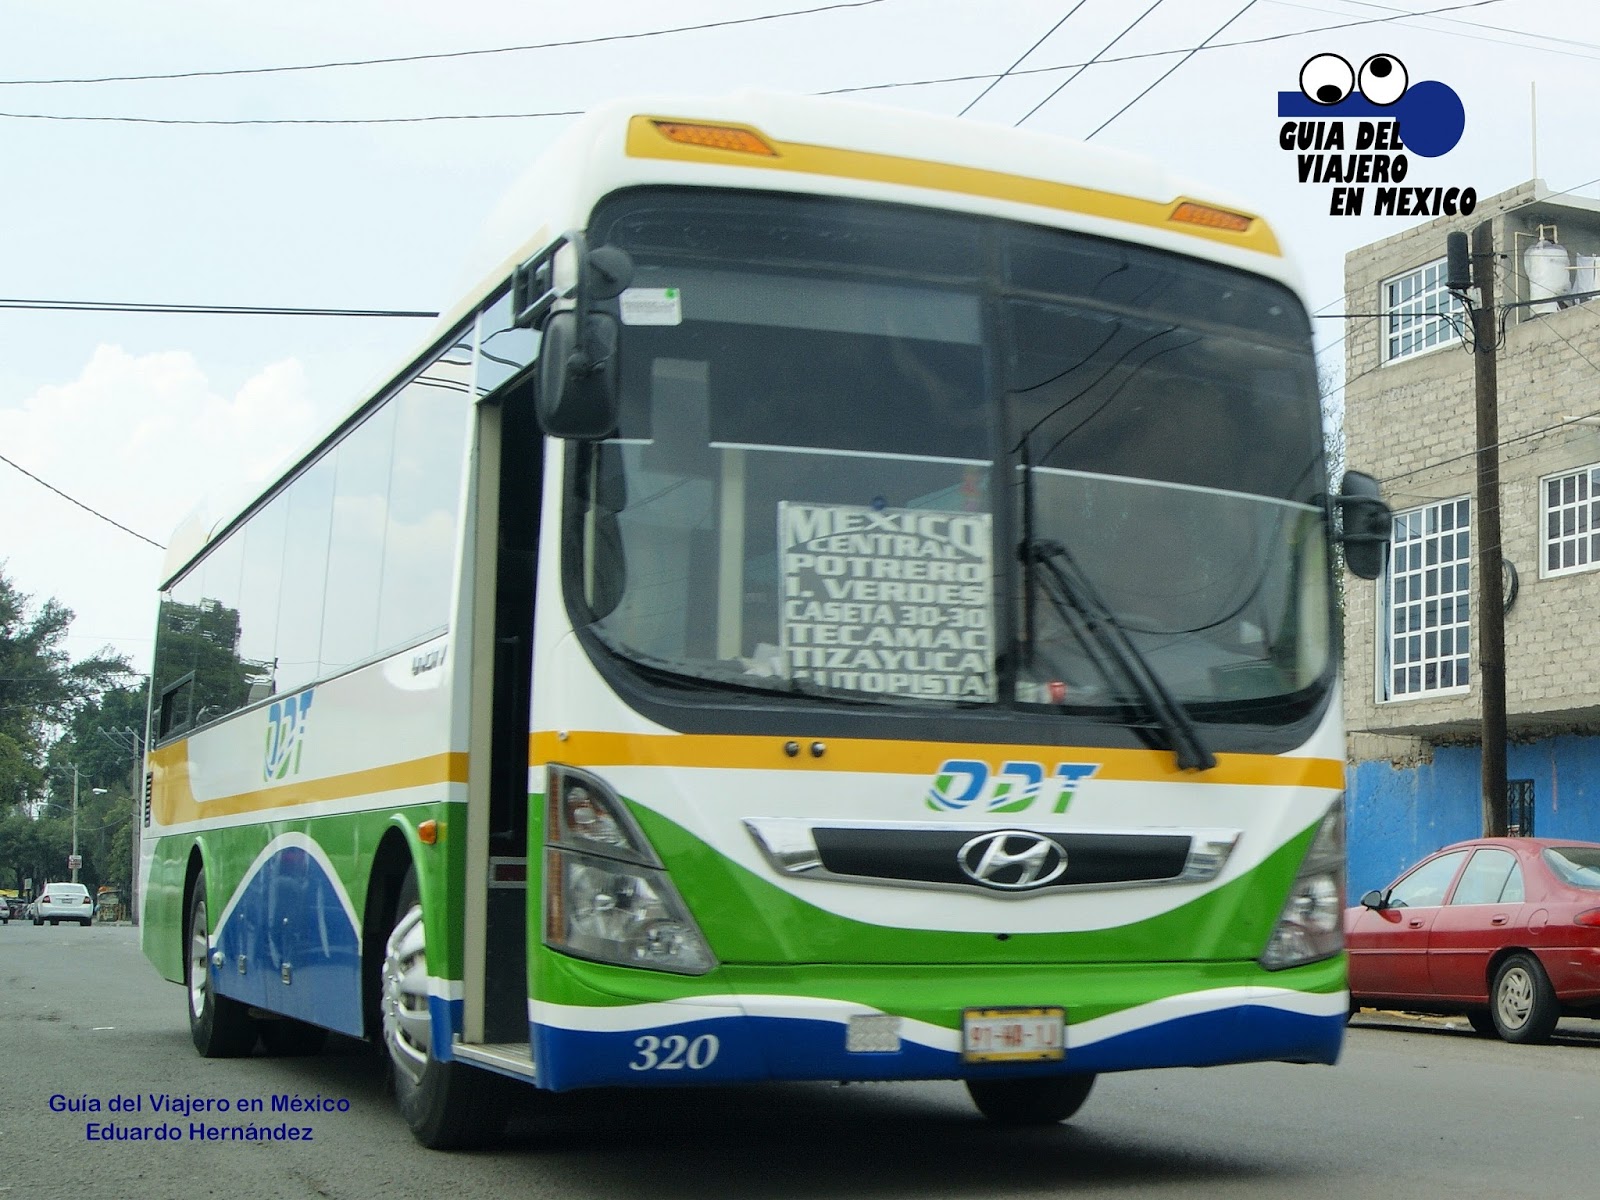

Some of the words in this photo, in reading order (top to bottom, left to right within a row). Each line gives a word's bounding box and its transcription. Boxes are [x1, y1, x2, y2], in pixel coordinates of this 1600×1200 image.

[786, 507, 986, 556] MEXICO
[807, 532, 965, 559] CENTRAL
[786, 553, 984, 582] POTRERO
[823, 579, 984, 605] VERDES
[786, 600, 895, 625] CASETA
[900, 605, 987, 628] 30-30
[786, 623, 988, 650] TECAMAC
[787, 648, 987, 673] TIZAYUCA
[925, 759, 1103, 814] ODT
[628, 1034, 720, 1071] 320
